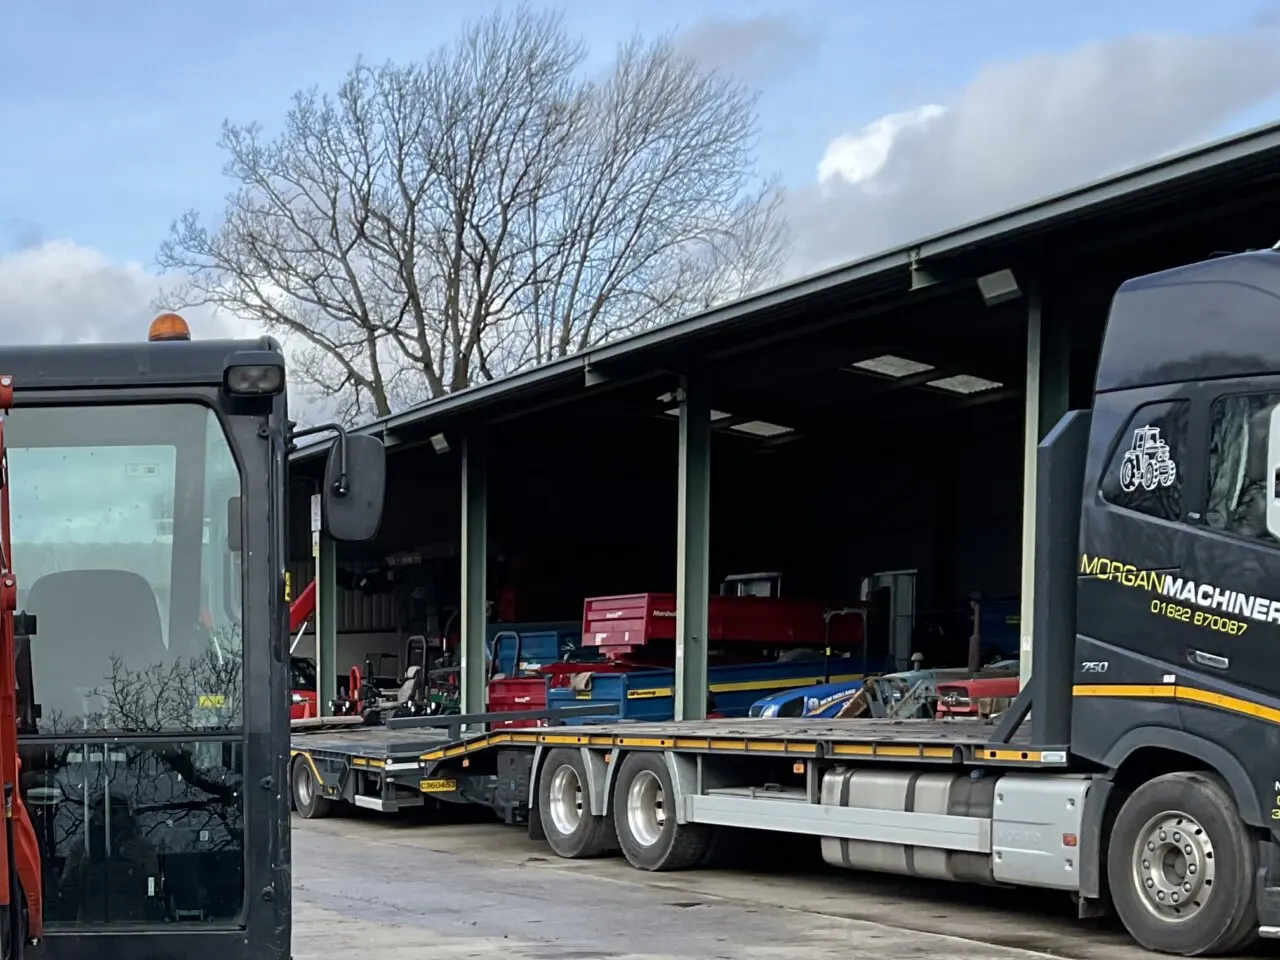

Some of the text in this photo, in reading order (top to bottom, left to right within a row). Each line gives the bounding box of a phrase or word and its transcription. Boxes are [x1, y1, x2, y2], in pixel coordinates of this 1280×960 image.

[1150, 599, 1248, 636] 01622 870087
[1080, 661, 1109, 673] 750
